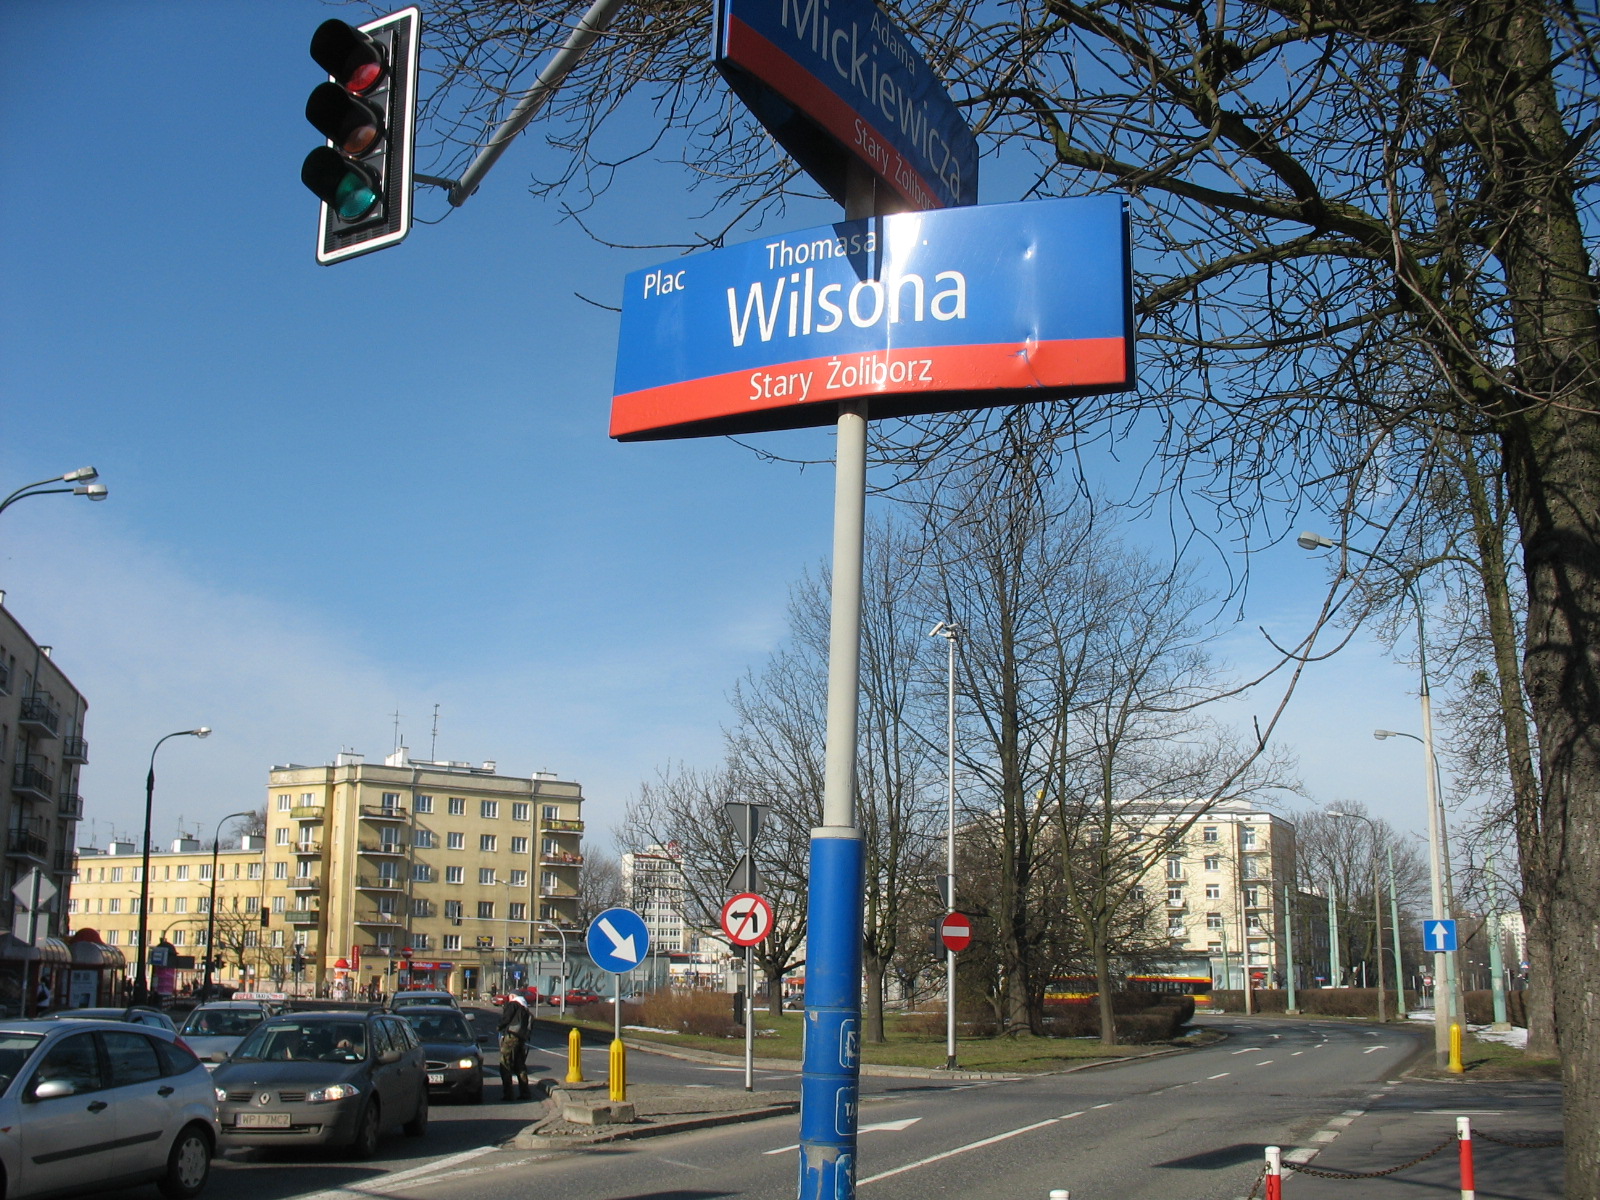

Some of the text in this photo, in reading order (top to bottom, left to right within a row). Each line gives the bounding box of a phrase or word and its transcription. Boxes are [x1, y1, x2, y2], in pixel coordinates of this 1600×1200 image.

[871, 12, 915, 76] Adama
[781, 0, 960, 204] Mickiewicza
[854, 119, 889, 175] Stary
[766, 231, 877, 270] Thomasa
[643, 269, 686, 299] Plac
[727, 267, 967, 347] Wilsona
[749, 355, 933, 402] Stary Żoliborz
